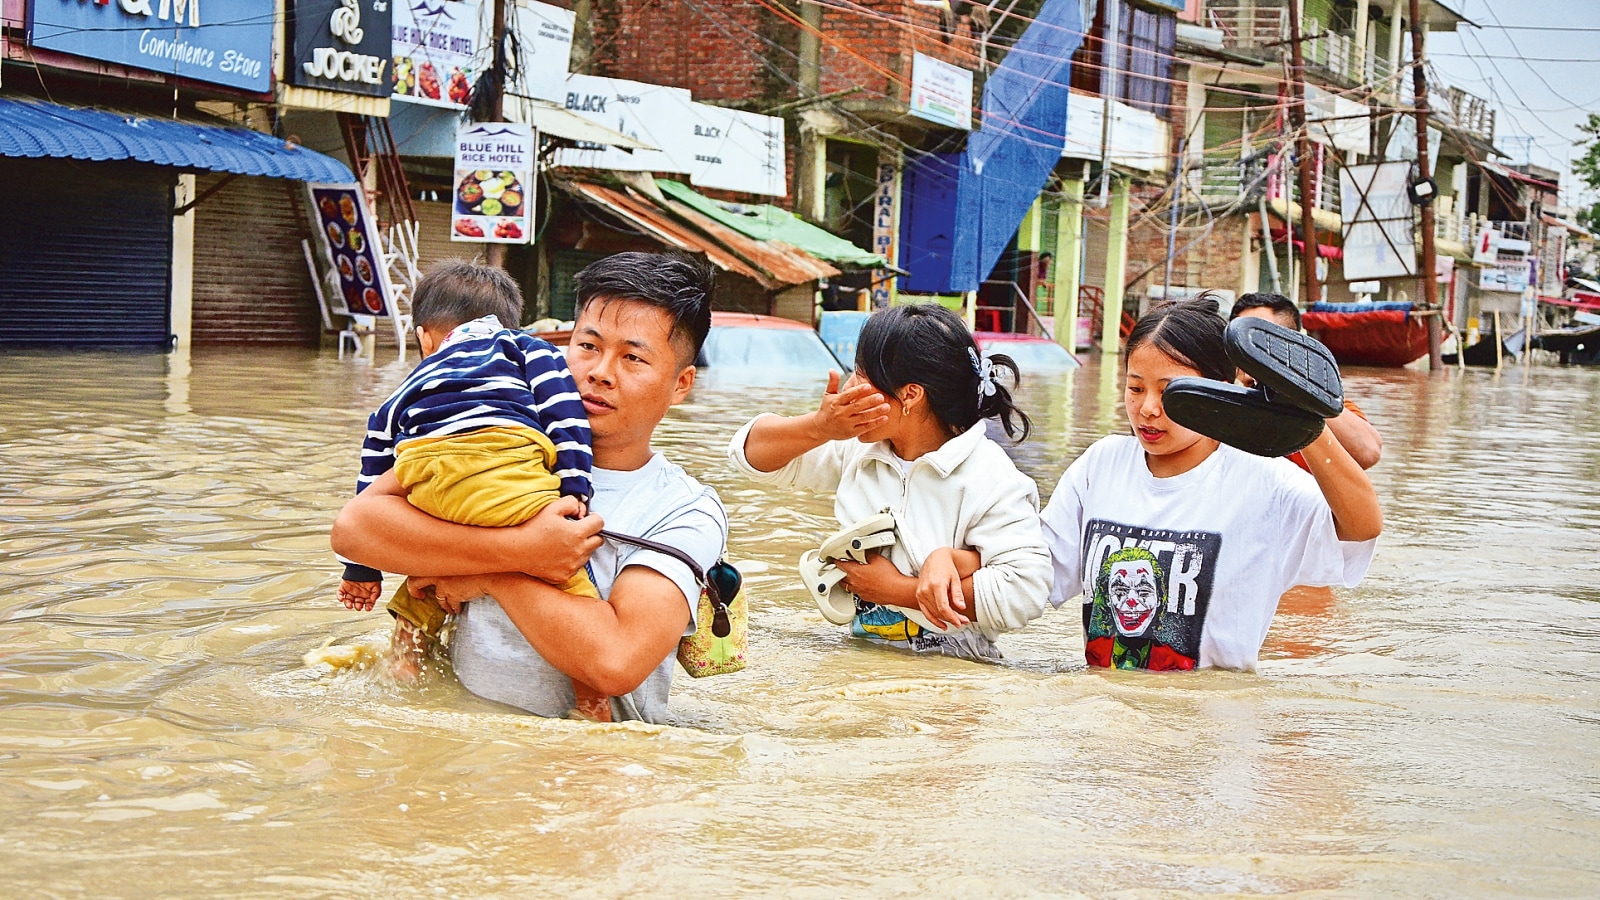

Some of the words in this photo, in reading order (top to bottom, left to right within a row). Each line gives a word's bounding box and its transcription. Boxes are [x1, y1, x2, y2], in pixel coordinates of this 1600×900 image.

[391, 25, 408, 43] LUE
[139, 29, 215, 68] Convinience
[219, 49, 261, 78] Store
[565, 91, 607, 114] BLACK
[460, 143, 492, 152] BLUE
[497, 144, 524, 153] HILL
[489, 155, 522, 163] HOTEL
[878, 163, 894, 228] SPIRAL
[1110, 525, 1122, 533] ON
[1141, 529, 1174, 538] HAPPY
[1180, 532, 1207, 540] FACE
